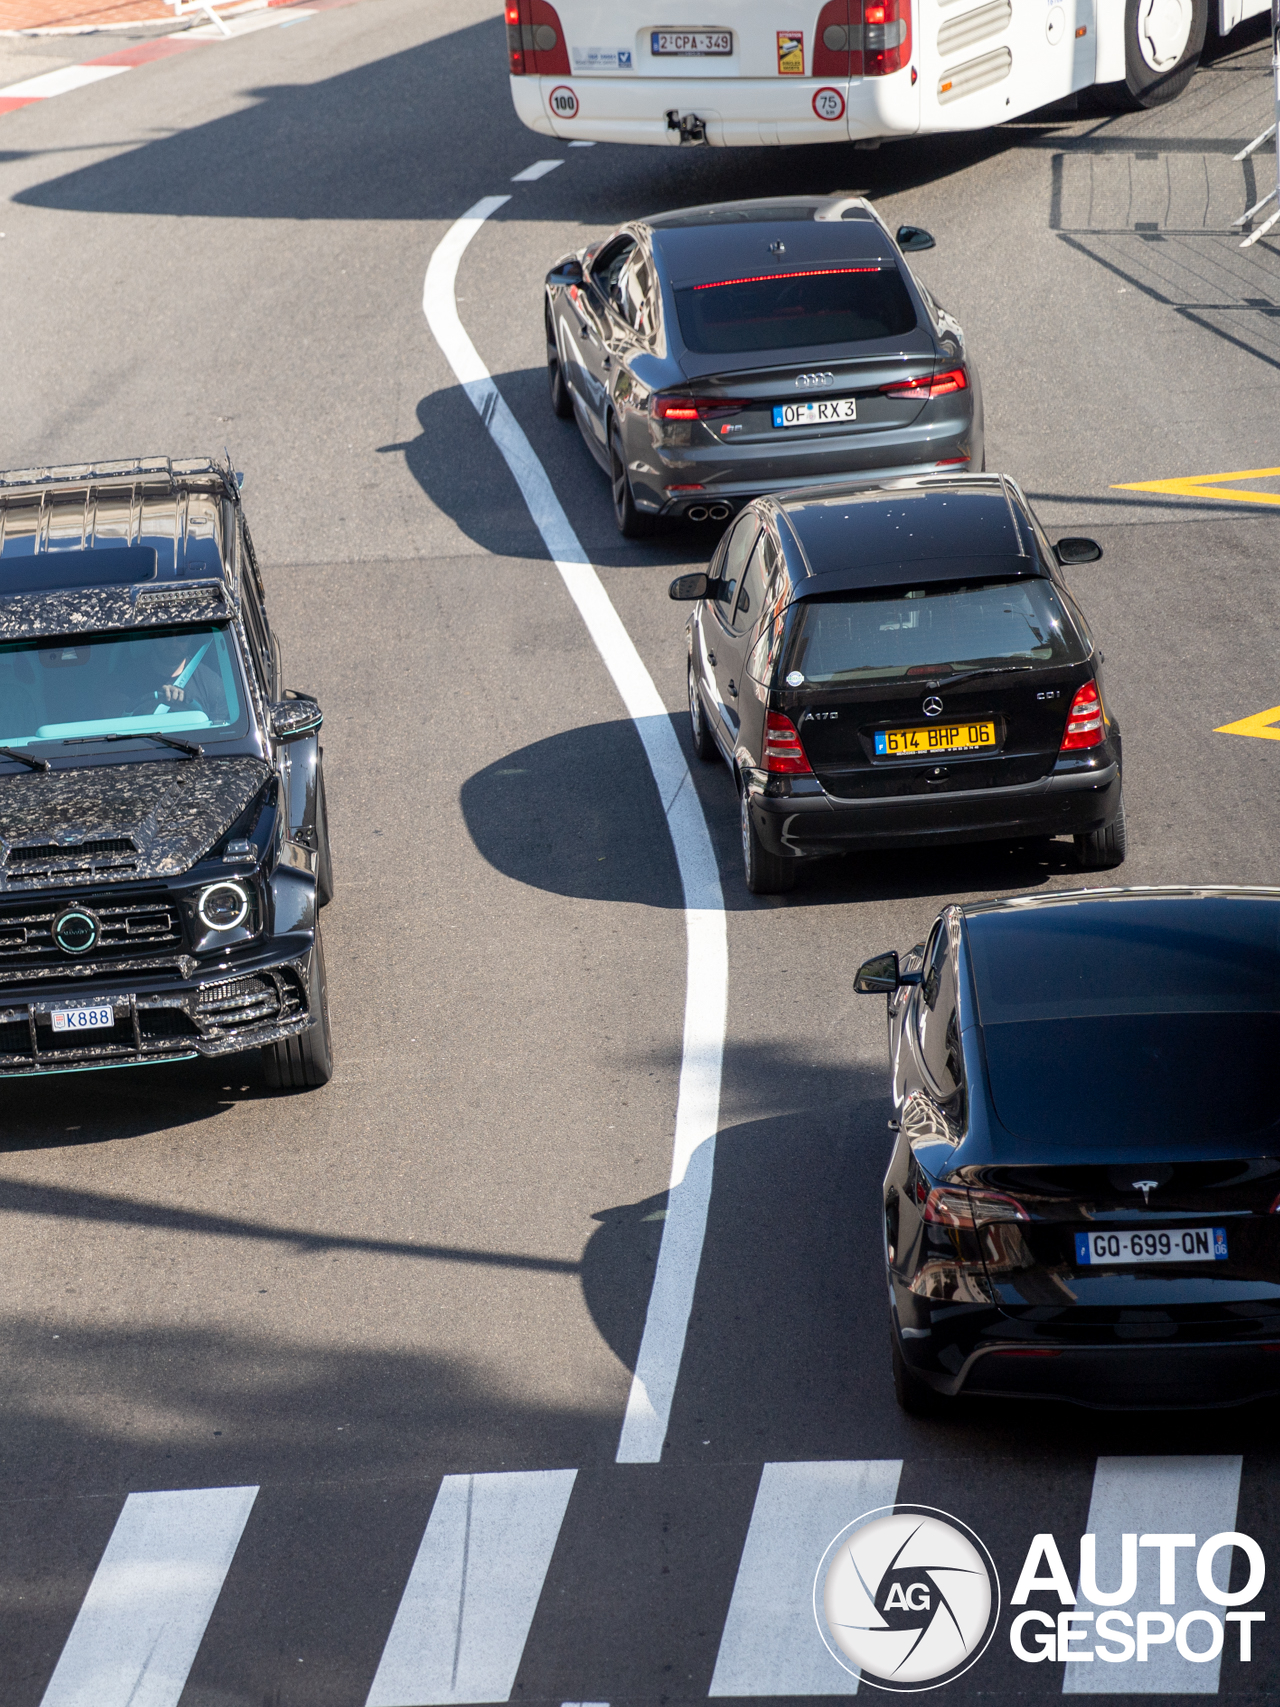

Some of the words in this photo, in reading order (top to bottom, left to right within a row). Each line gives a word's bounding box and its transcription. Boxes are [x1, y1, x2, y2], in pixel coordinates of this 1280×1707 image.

[554, 96, 575, 110] 100
[820, 95, 837, 109] 75
[784, 405, 806, 422] OF
[818, 402, 840, 419] RX
[844, 401, 854, 417] 3
[887, 731, 920, 750] 614
[927, 727, 959, 747] BHP
[968, 725, 990, 743] 06
[66, 1009, 109, 1028] K888
[1093, 1231, 1210, 1257] GQ-699-QN
[1214, 1243, 1228, 1255] 06
